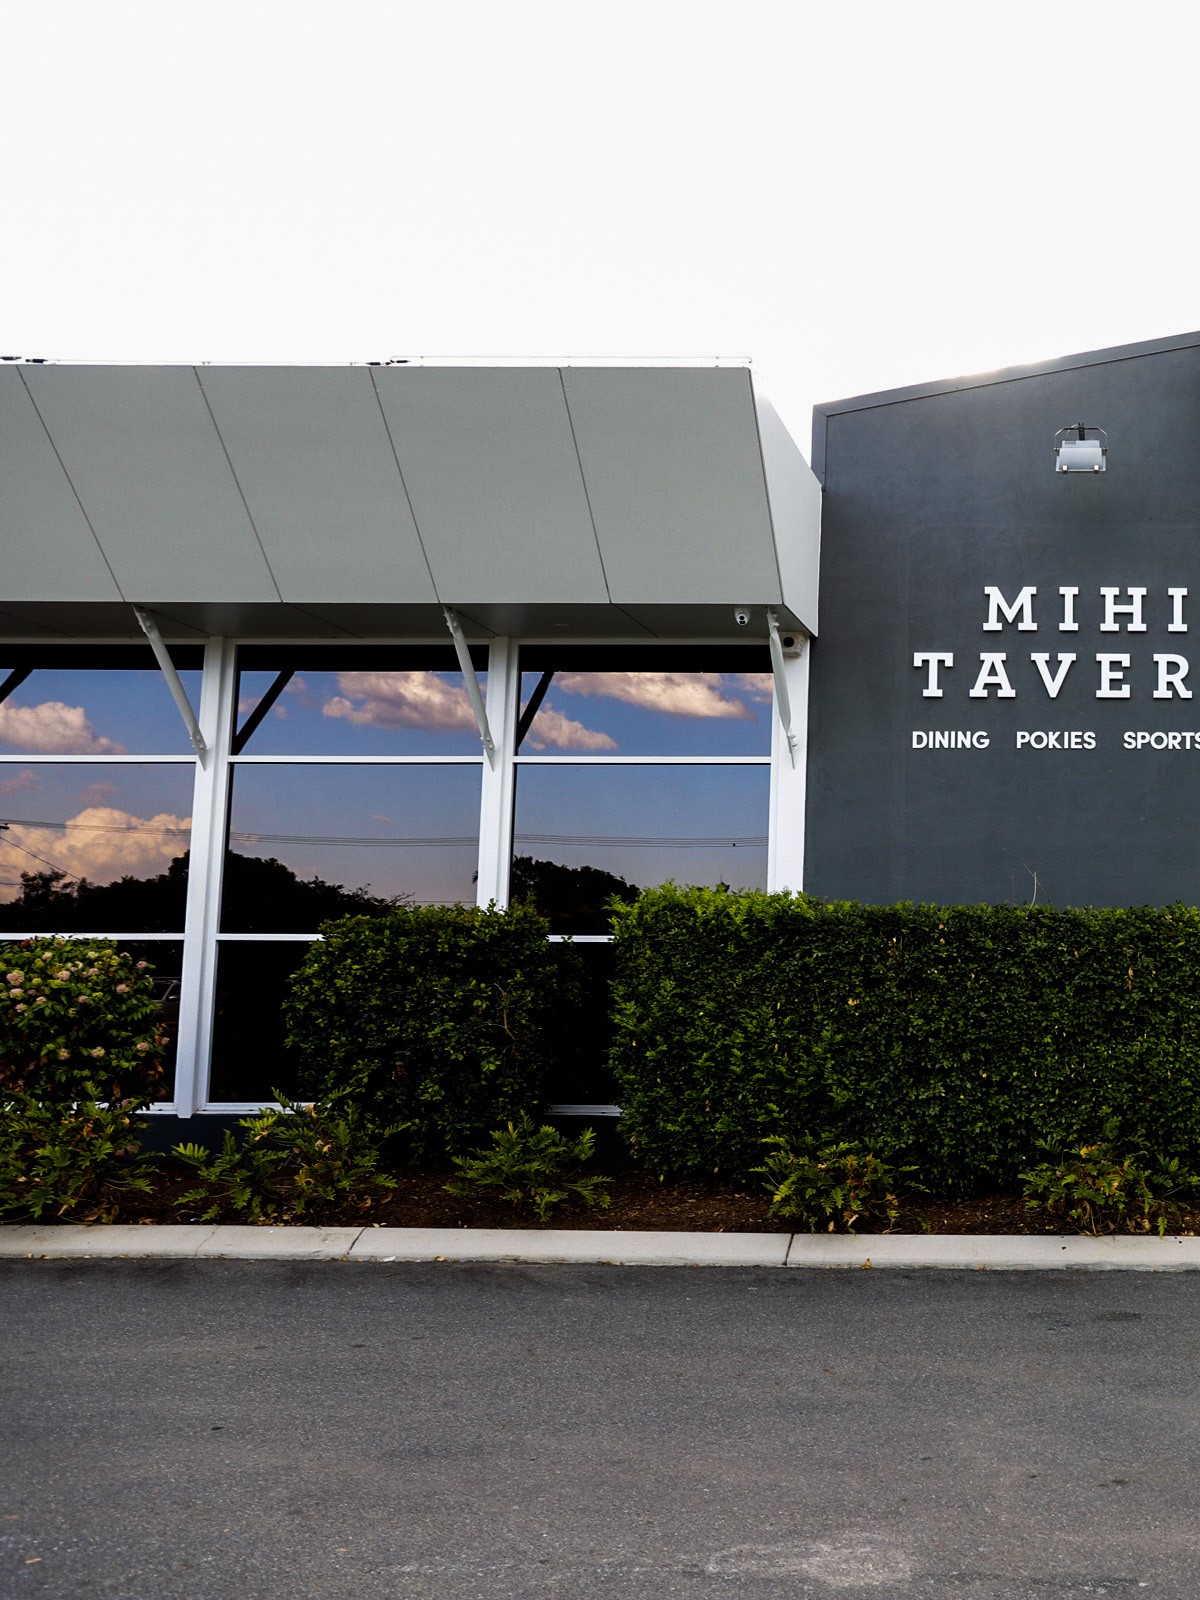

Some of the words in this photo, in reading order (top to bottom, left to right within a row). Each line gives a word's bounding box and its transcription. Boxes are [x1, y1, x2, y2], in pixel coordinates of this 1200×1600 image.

[982, 586, 1188, 632] MIHI
[912, 731, 990, 749] DINING
[1016, 731, 1097, 749] POKIES
